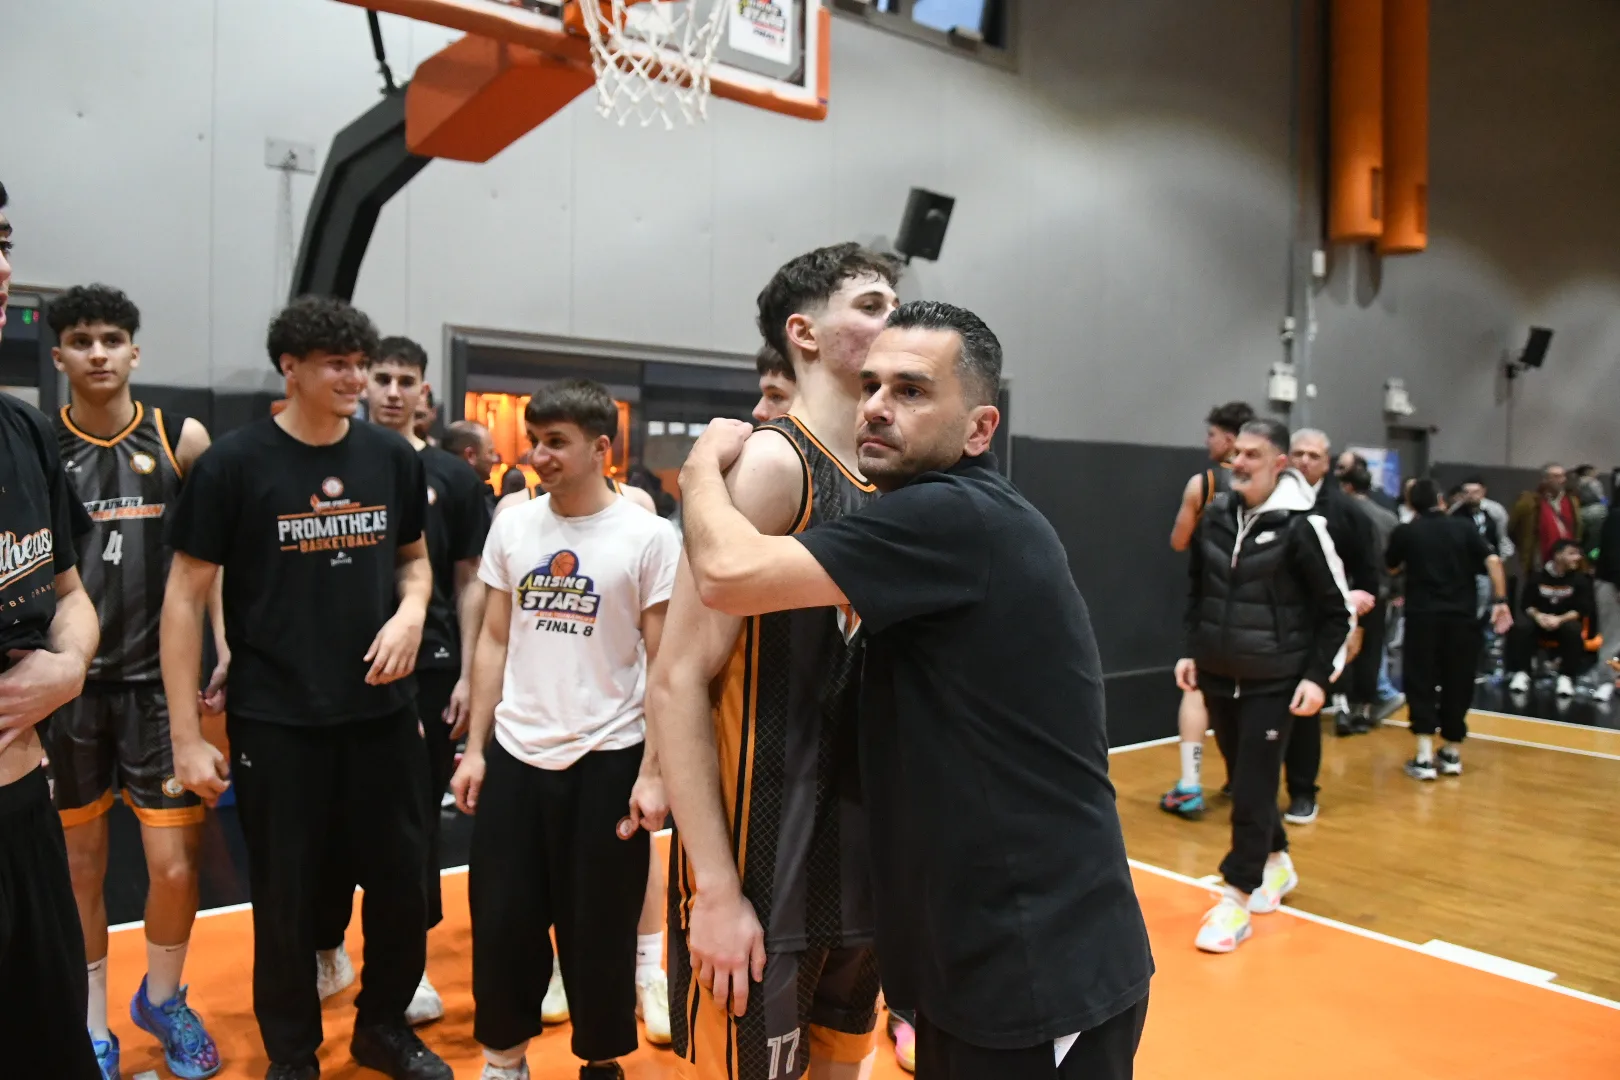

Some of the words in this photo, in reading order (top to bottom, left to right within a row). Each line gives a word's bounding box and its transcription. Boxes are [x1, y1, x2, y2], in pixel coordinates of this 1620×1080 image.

[278, 511, 387, 541] PROMITHEAS
[102, 530, 123, 565] 4
[300, 533, 378, 553] BASKETBALL
[533, 575, 587, 590] RISING
[523, 591, 597, 614] STARS
[536, 619, 578, 635] FINAL
[583, 625, 594, 637] 8
[767, 1027, 800, 1080] 17
